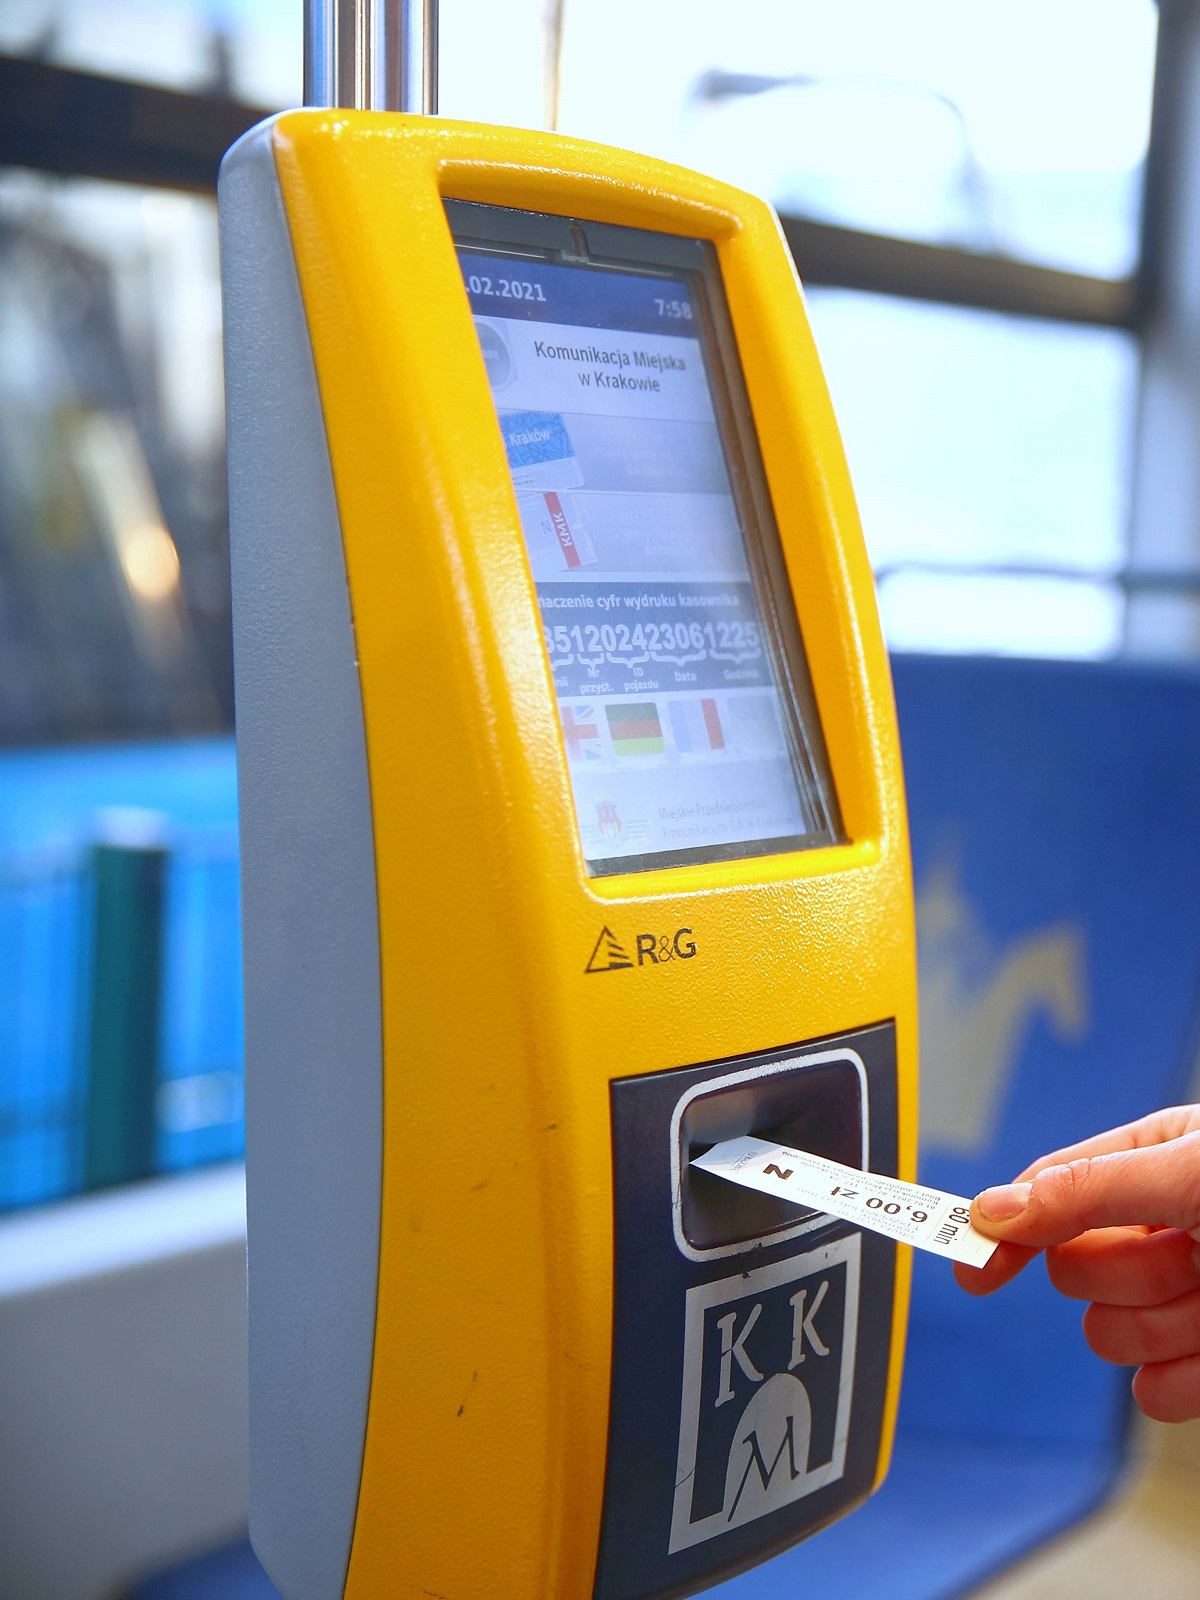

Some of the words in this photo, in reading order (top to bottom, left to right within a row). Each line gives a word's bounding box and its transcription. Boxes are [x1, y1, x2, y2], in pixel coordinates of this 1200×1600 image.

[654, 299, 693, 320] 7:58
[534, 341, 630, 366] Komunikacja
[634, 351, 686, 373] Miejska
[578, 372, 590, 386] w
[595, 371, 661, 393] Krakowie
[508, 429, 550, 446] Kraków
[554, 512, 572, 547] KMK
[597, 594, 621, 611] cyfr
[624, 593, 676, 611] wydruku
[674, 671, 697, 682] Data
[580, 682, 614, 696] przyst.
[624, 680, 659, 692] pojazdu
[636, 927, 697, 966] R&G
[830, 1186, 859, 1200] zł
[866, 1197, 928, 1223] 6,00
[949, 1206, 970, 1224] 60
[933, 1223, 959, 1245] min
